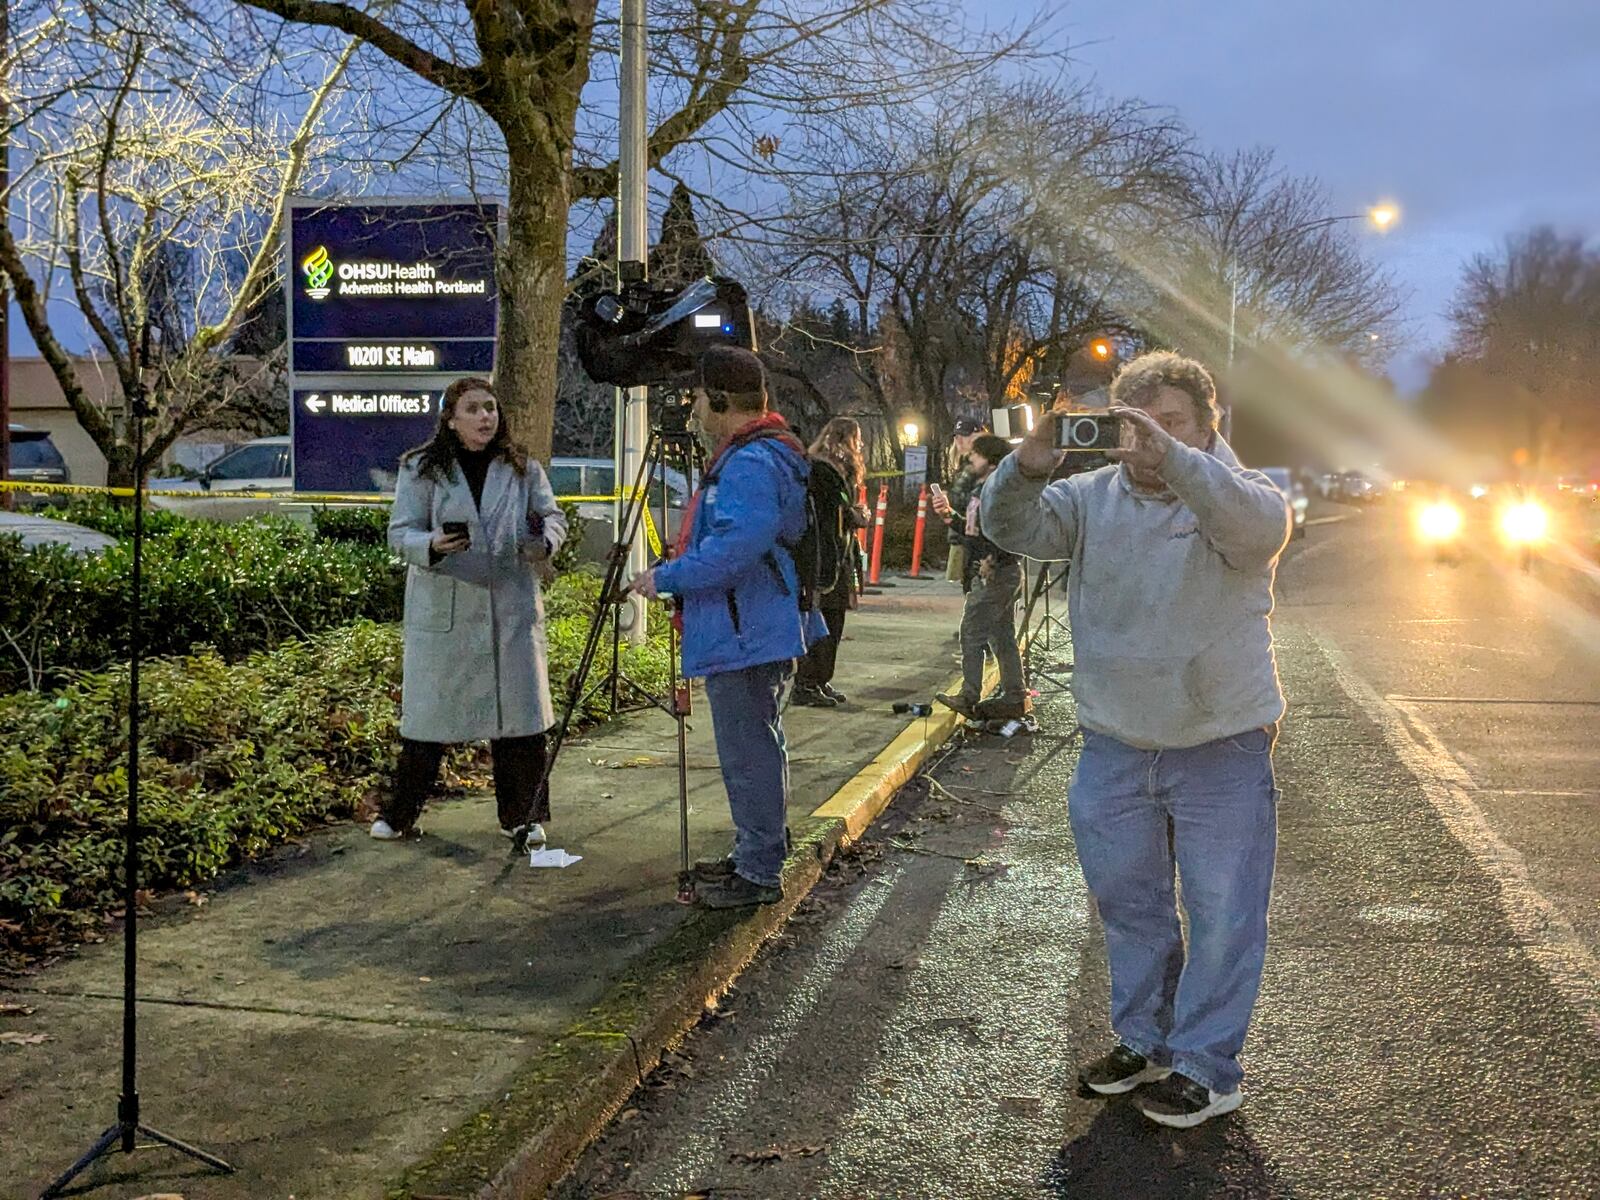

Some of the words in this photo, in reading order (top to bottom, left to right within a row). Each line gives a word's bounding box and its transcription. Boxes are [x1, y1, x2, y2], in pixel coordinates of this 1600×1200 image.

[339, 281, 393, 295] Adventist
[395, 281, 433, 294] Health
[435, 279, 485, 294] Portland
[347, 346, 383, 366] 10201
[385, 346, 402, 366] SE
[403, 346, 435, 366] Main
[332, 394, 378, 413] Medical
[379, 394, 420, 413] Offices
[421, 394, 430, 413] 3
